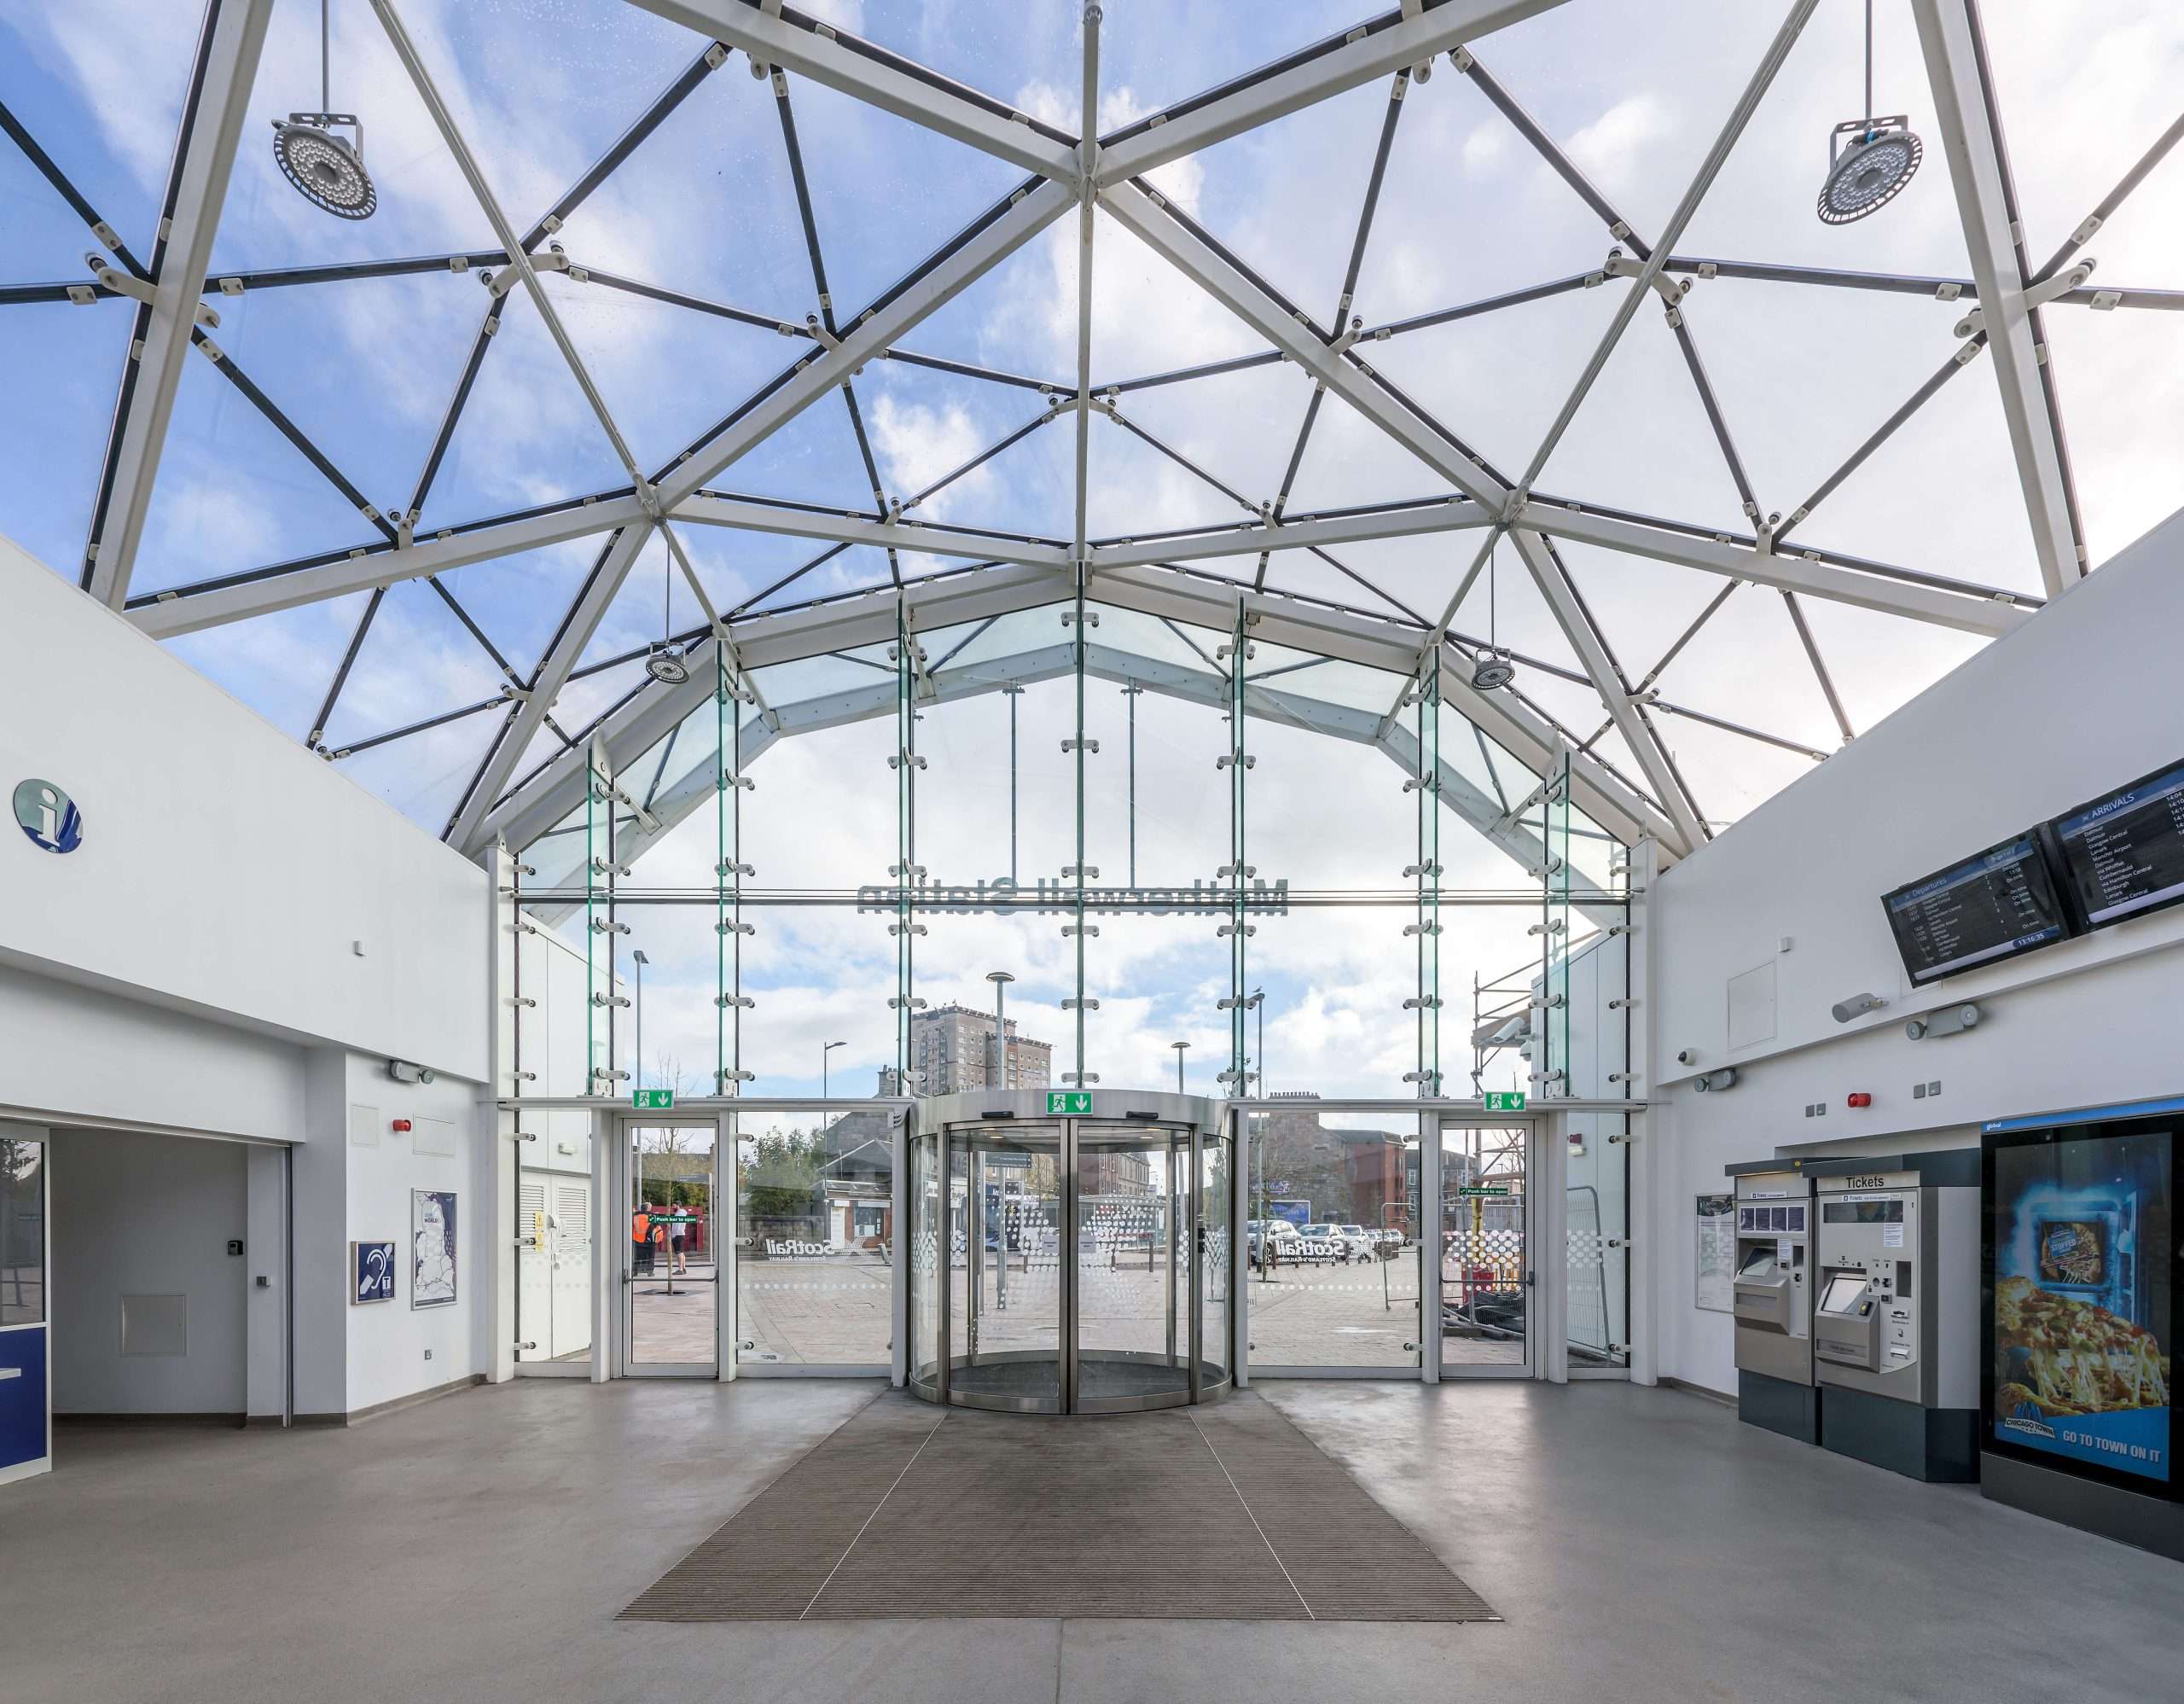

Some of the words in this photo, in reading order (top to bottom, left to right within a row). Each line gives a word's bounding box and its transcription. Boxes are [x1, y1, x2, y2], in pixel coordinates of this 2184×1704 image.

[2092, 793, 2135, 819] ARRIVALS
[2114, 843, 2132, 854] Airport
[2133, 864, 2152, 875] Central
[1913, 878, 1947, 896] Departures
[2018, 933, 2045, 946] 13:16:35
[1986, 1122, 2001, 1131] global
[1845, 1177, 1885, 1189] Tickets
[2007, 1419, 2034, 1428] CHICAGO
[2034, 1423, 2053, 1435] TOWN
[2063, 1430, 2077, 1443] GO
[2079, 1433, 2093, 1446] TO
[2095, 1437, 2127, 1455] TOWN
[2130, 1445, 2146, 1459] ON
[2149, 1449, 2160, 1463] IT
